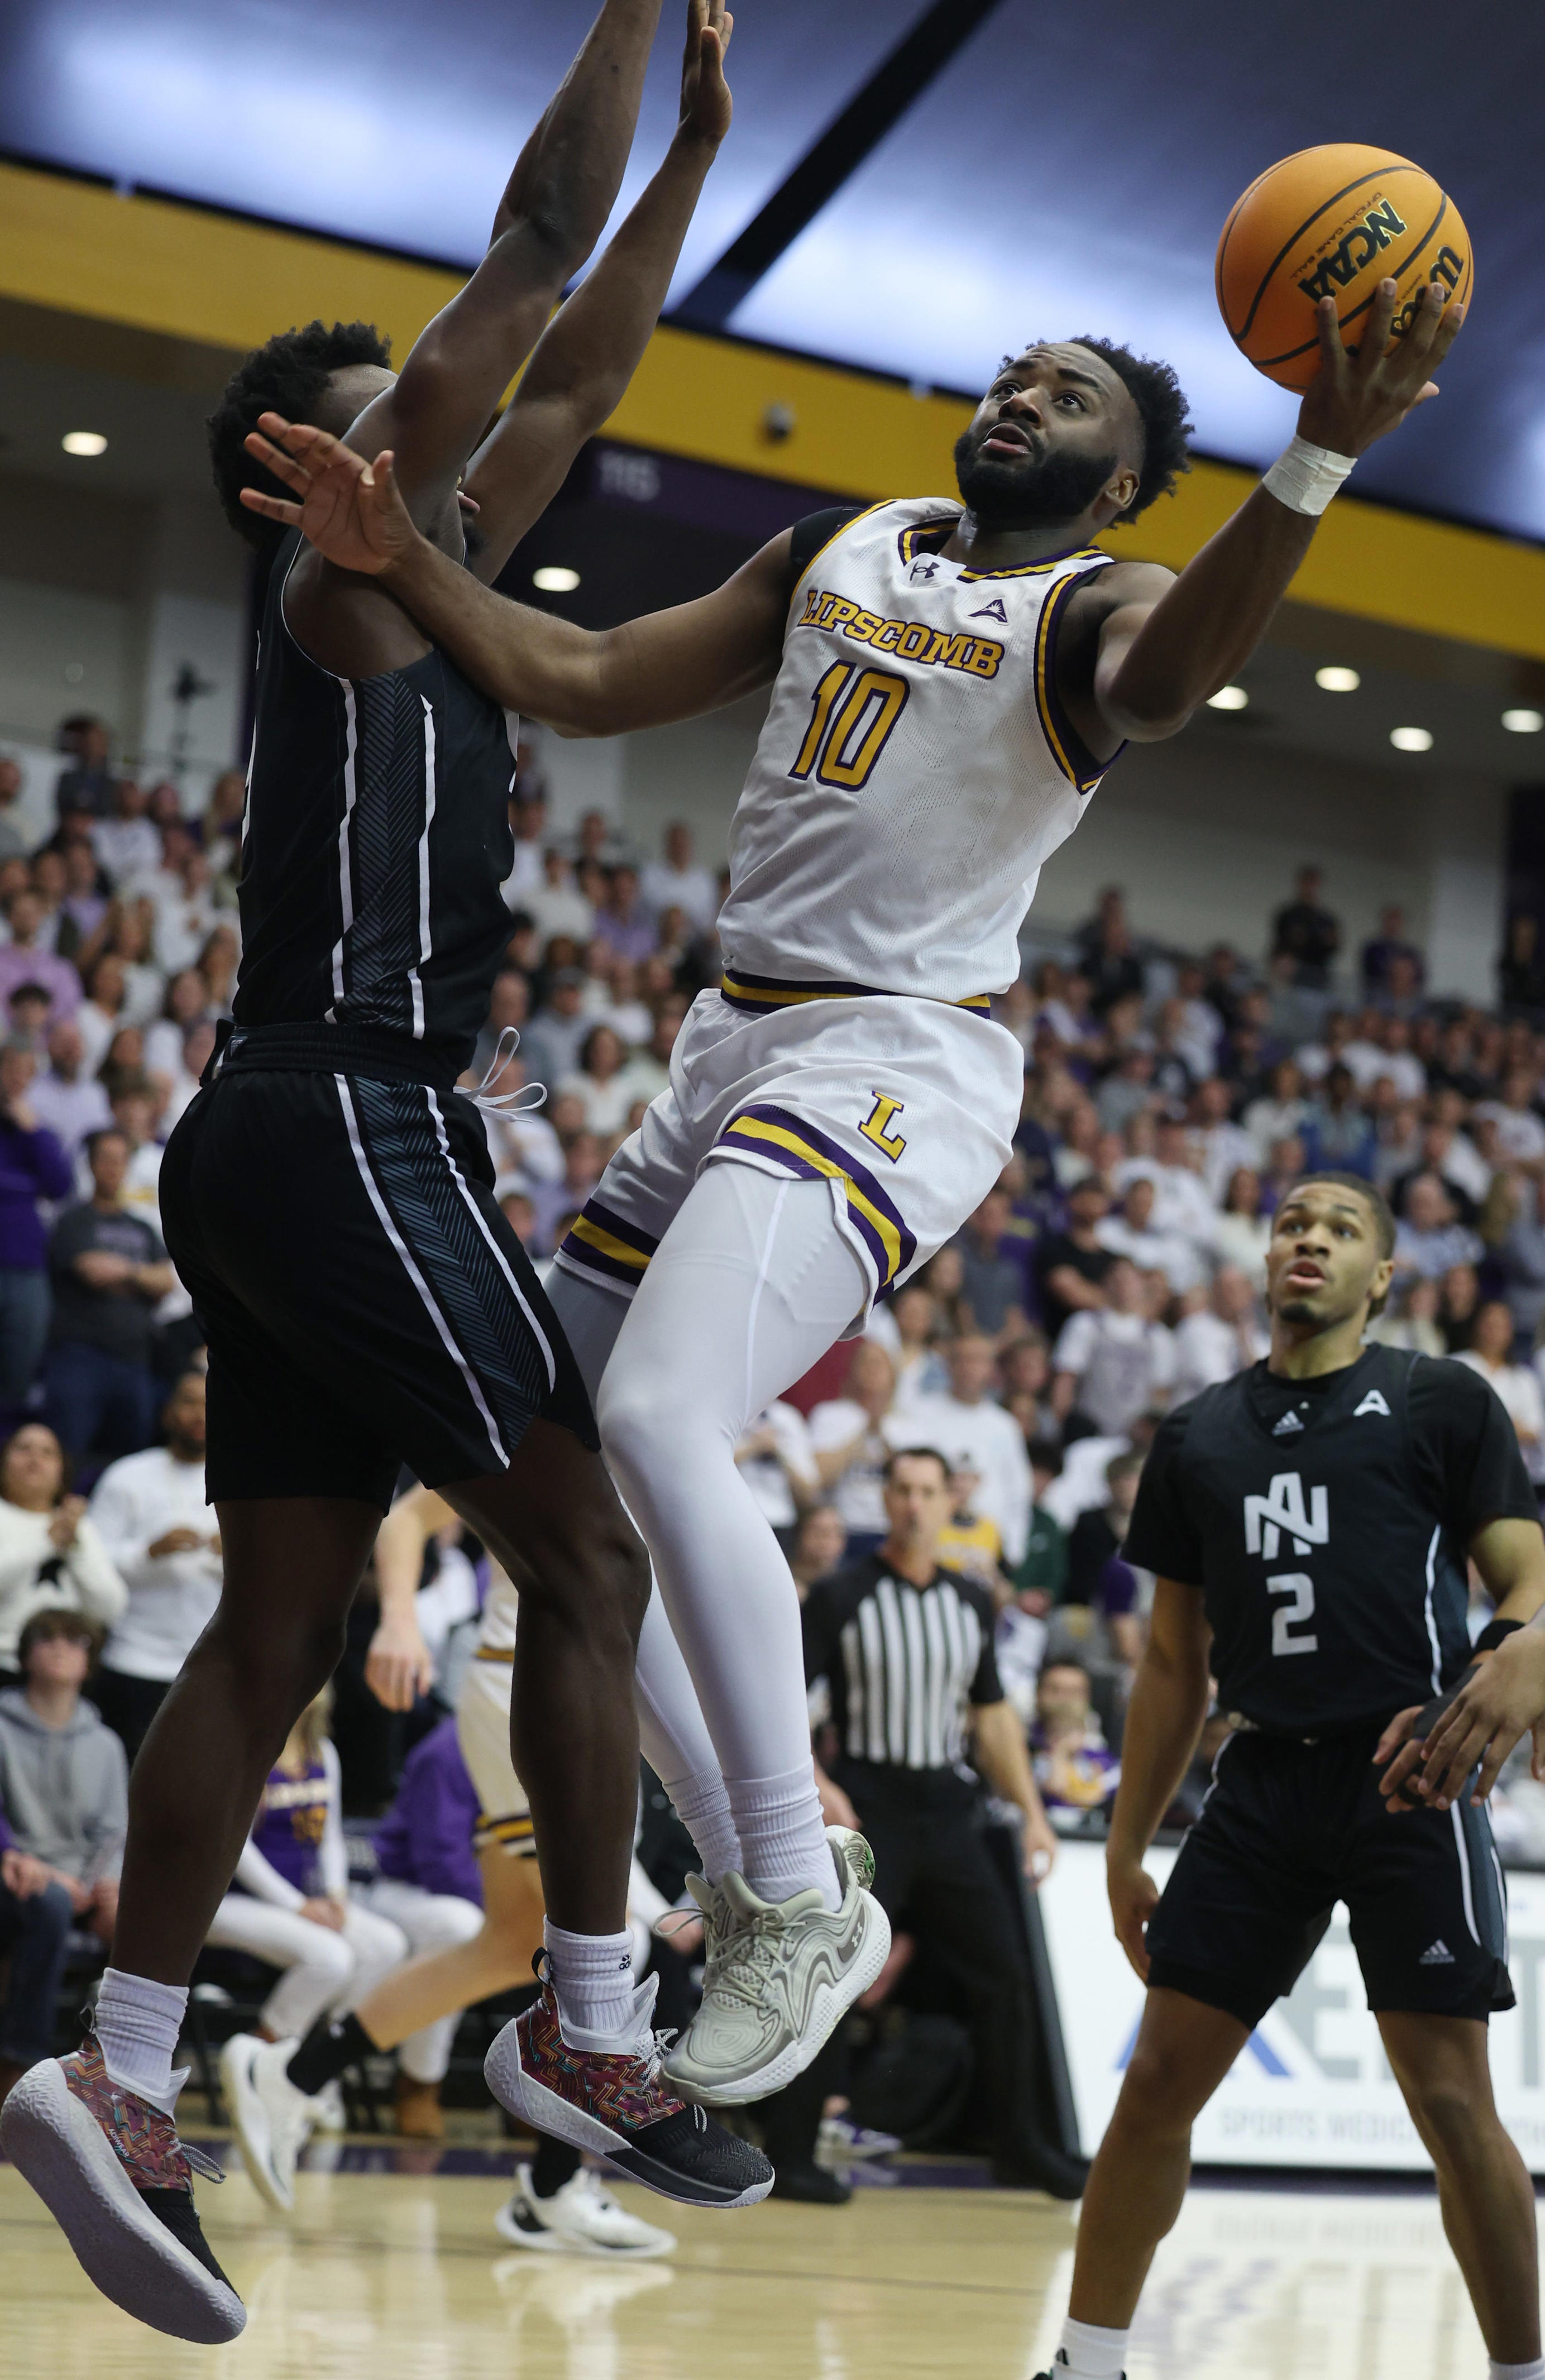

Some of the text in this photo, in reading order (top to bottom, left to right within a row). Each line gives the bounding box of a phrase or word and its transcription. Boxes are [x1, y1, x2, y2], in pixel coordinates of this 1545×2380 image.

[1290, 192, 1382, 279] OFFICIAL GAME BALL
[1297, 198, 1408, 304] NCAA
[797, 590, 1005, 680] LIPSCOMB
[787, 659, 910, 792] 10
[857, 1090, 907, 1164] L
[1266, 1572, 1318, 1656] 2
[108, 2128, 130, 2158] ADIWEAR
